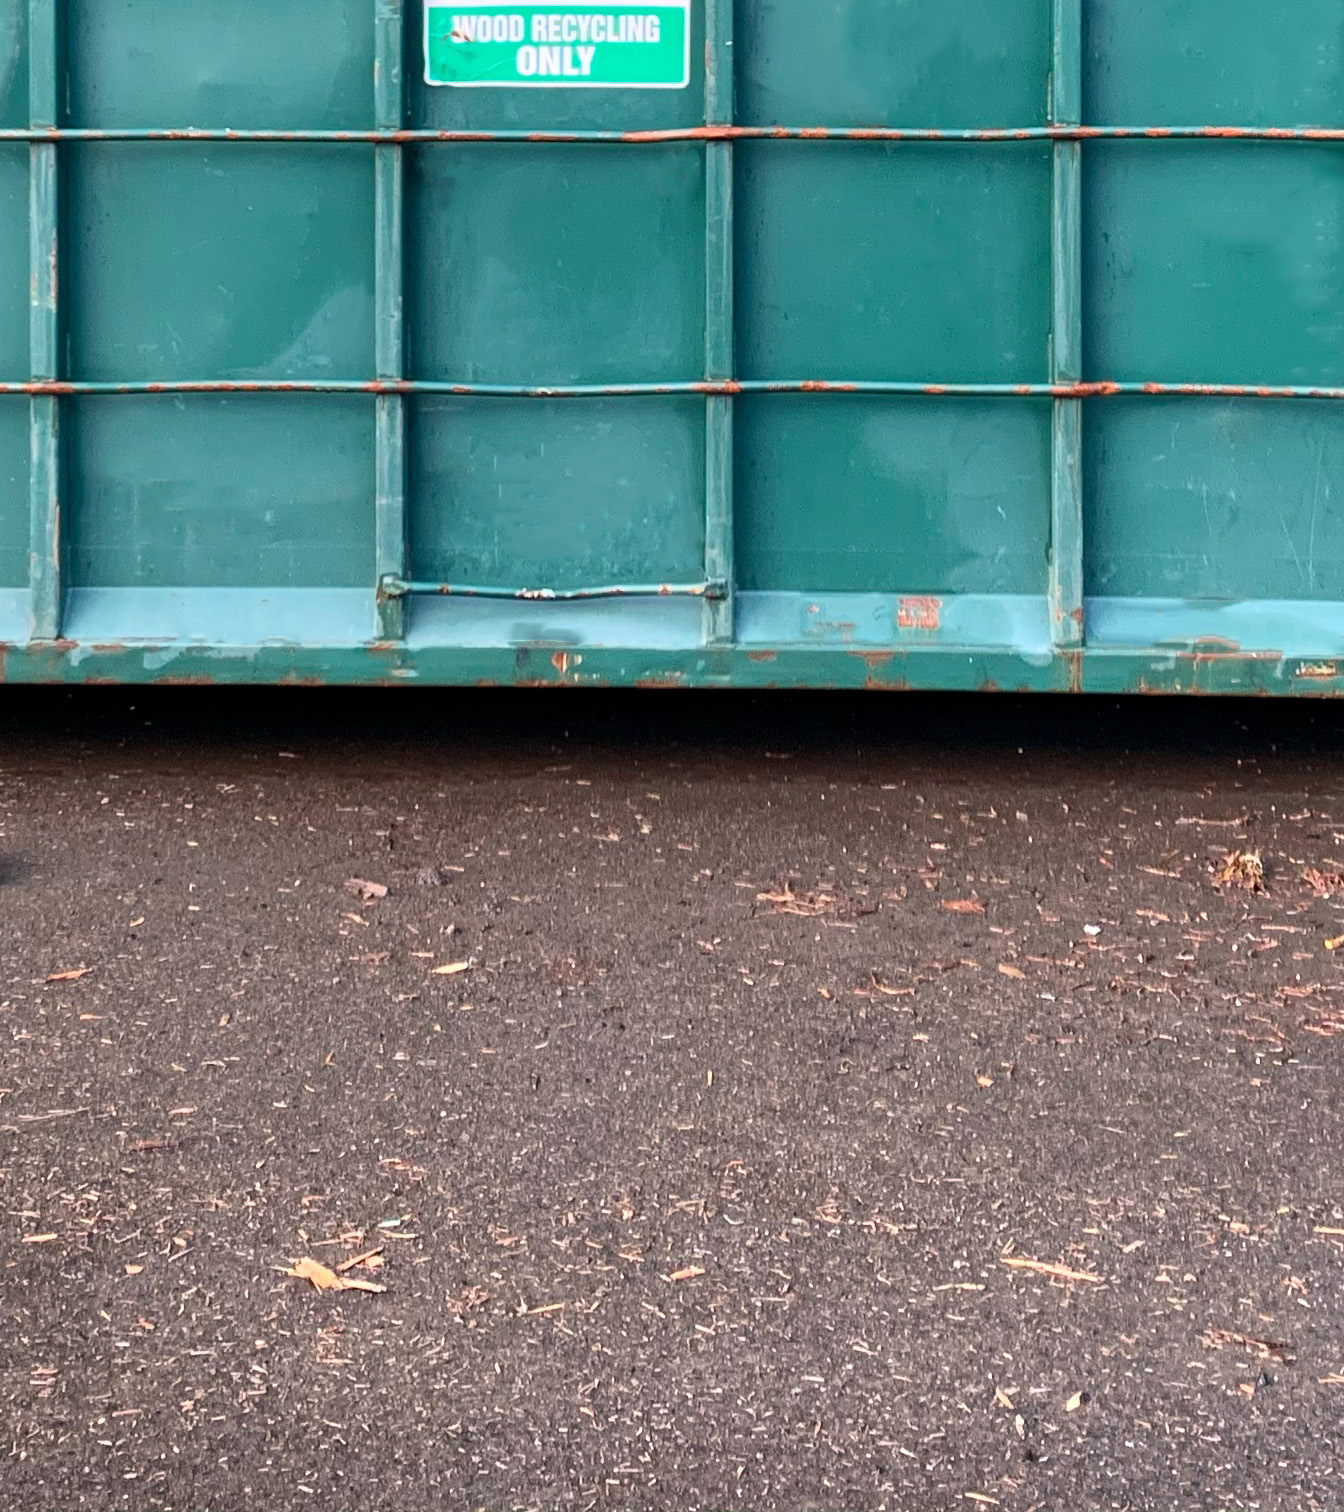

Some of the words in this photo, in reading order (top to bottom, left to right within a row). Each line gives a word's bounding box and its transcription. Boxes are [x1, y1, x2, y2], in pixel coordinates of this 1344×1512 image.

[451, 15, 525, 43] WOOD
[531, 14, 661, 43] RECYCLING
[516, 45, 596, 76] ONLY
